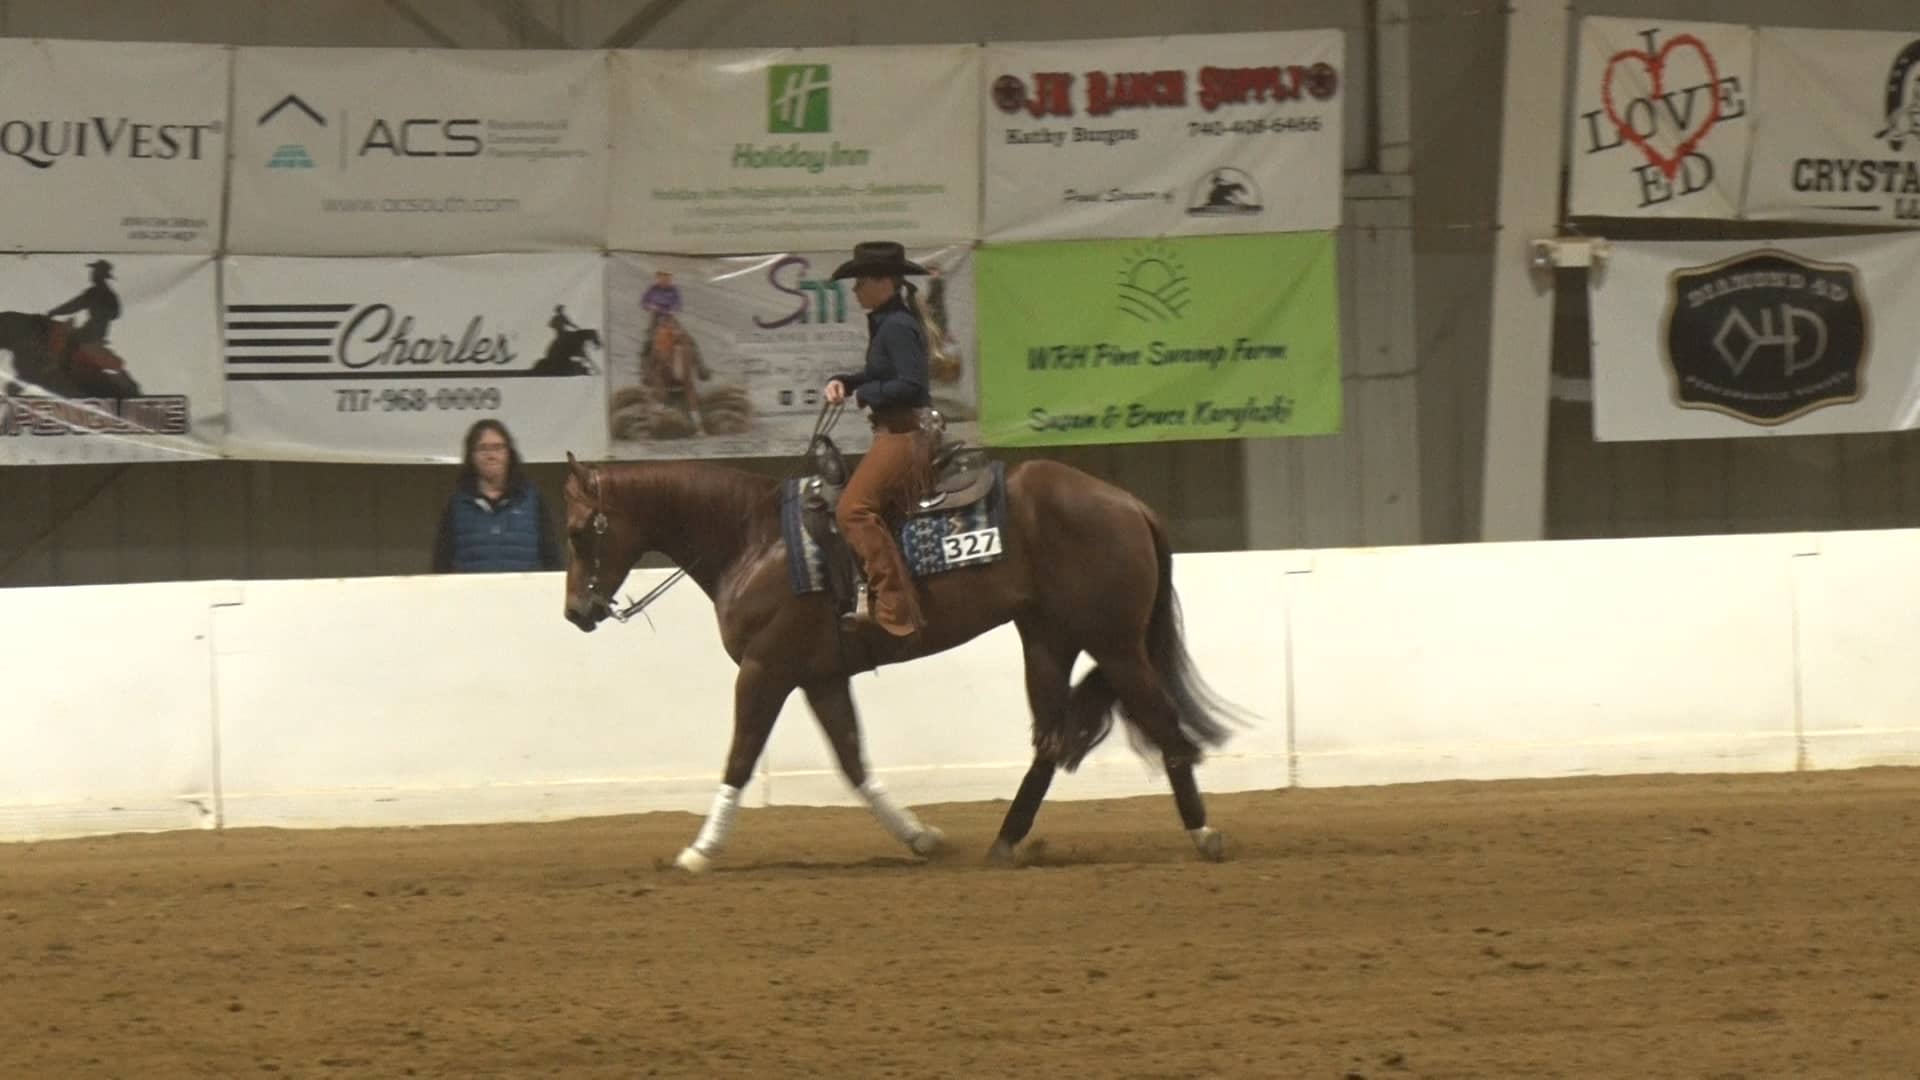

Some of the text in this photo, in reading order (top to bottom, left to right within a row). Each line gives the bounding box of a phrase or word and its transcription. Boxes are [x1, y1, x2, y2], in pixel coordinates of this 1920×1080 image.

[1085, 70, 1187, 117] RANCH
[1197, 65, 1309, 112] SUPPLY
[1581, 76, 1746, 154] LOVE
[358, 119, 483, 156] ACS
[732, 142, 872, 174] Holiday Inn
[1631, 152, 1714, 208] ED
[338, 303, 519, 369] Charles
[1091, 343, 1141, 368] Pine
[1147, 340, 1229, 370] Swamp
[1231, 337, 1287, 361] Farm
[1028, 407, 1097, 432] Susan
[1101, 404, 1122, 430] &
[1124, 403, 1187, 429] Bruce
[944, 531, 996, 560] 327
